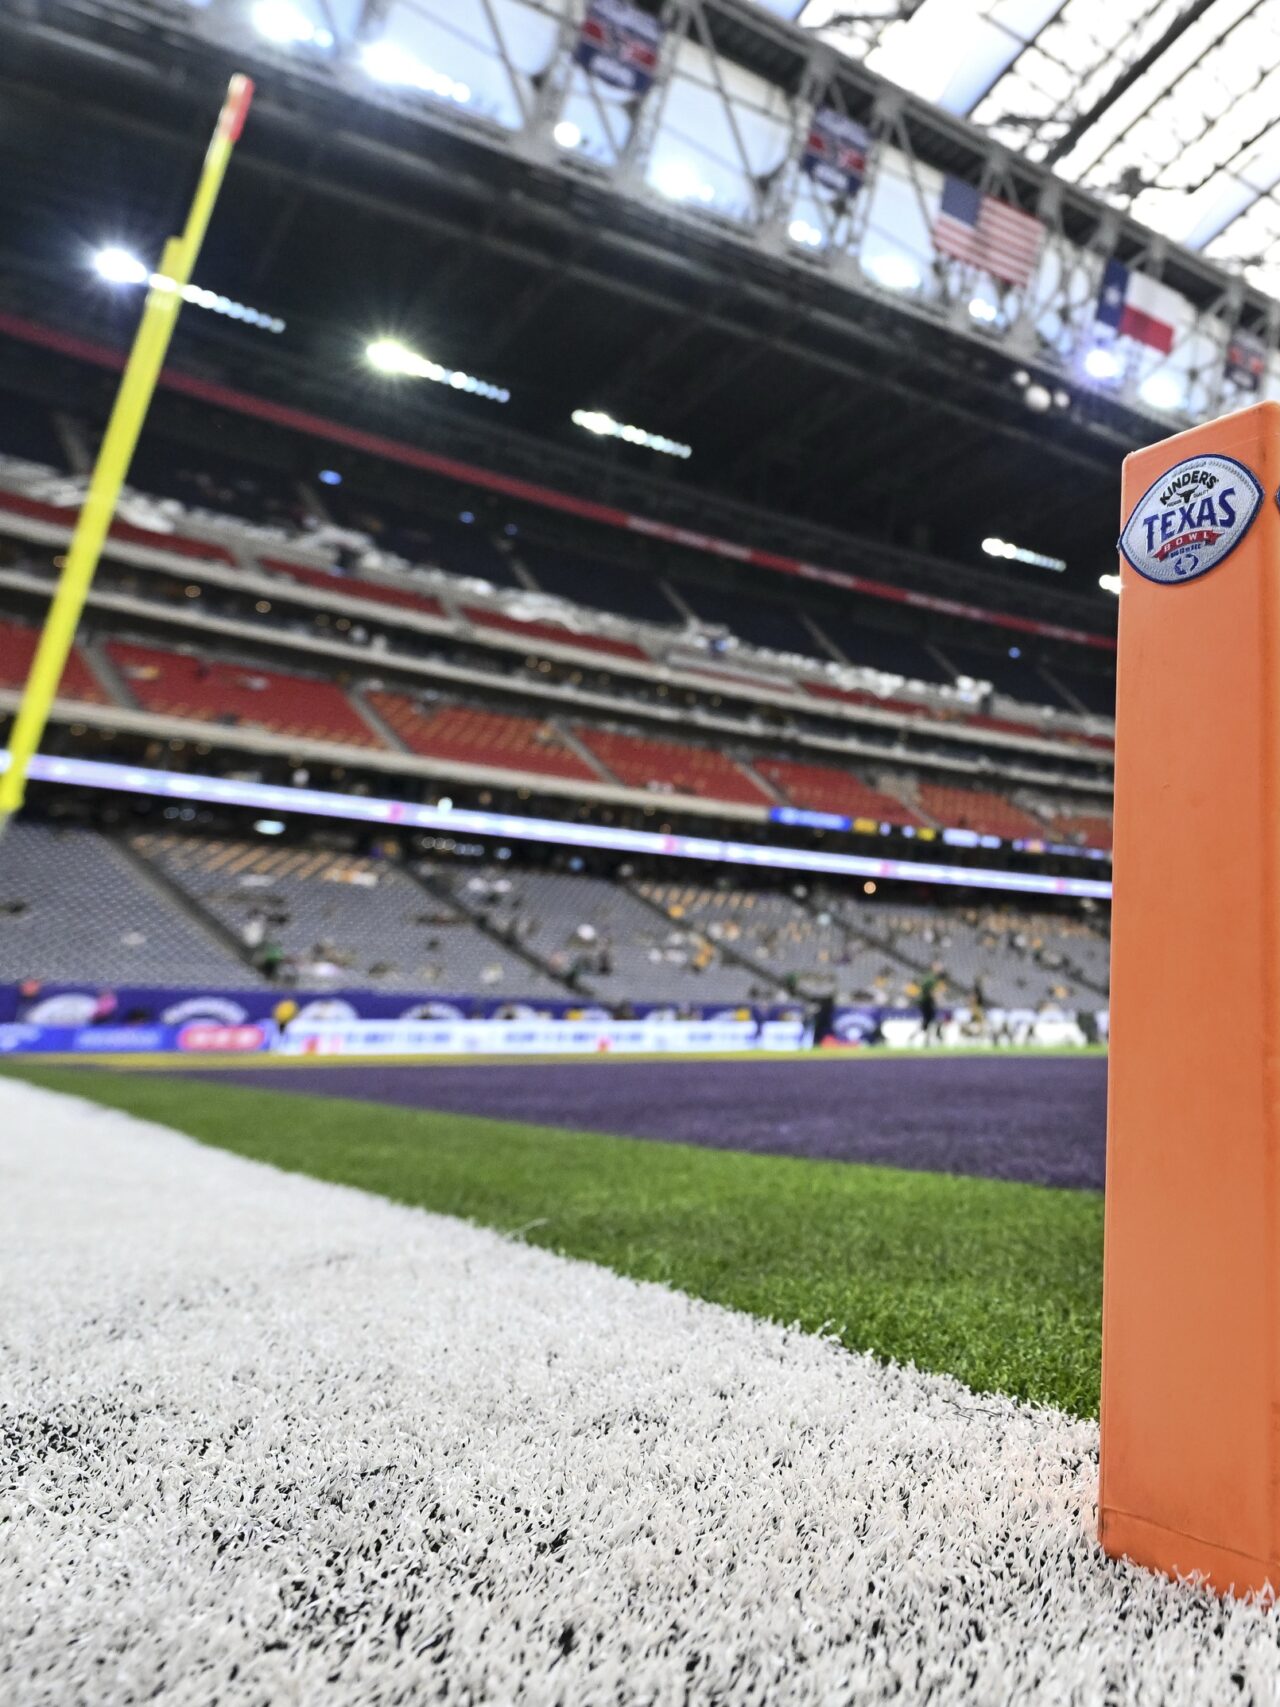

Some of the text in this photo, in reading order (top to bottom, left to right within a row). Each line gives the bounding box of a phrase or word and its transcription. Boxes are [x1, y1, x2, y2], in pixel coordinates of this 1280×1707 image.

[1160, 470, 1217, 505] KINDER'S
[1143, 487, 1236, 551] TEXAS
[1164, 531, 1209, 552] BOWL
